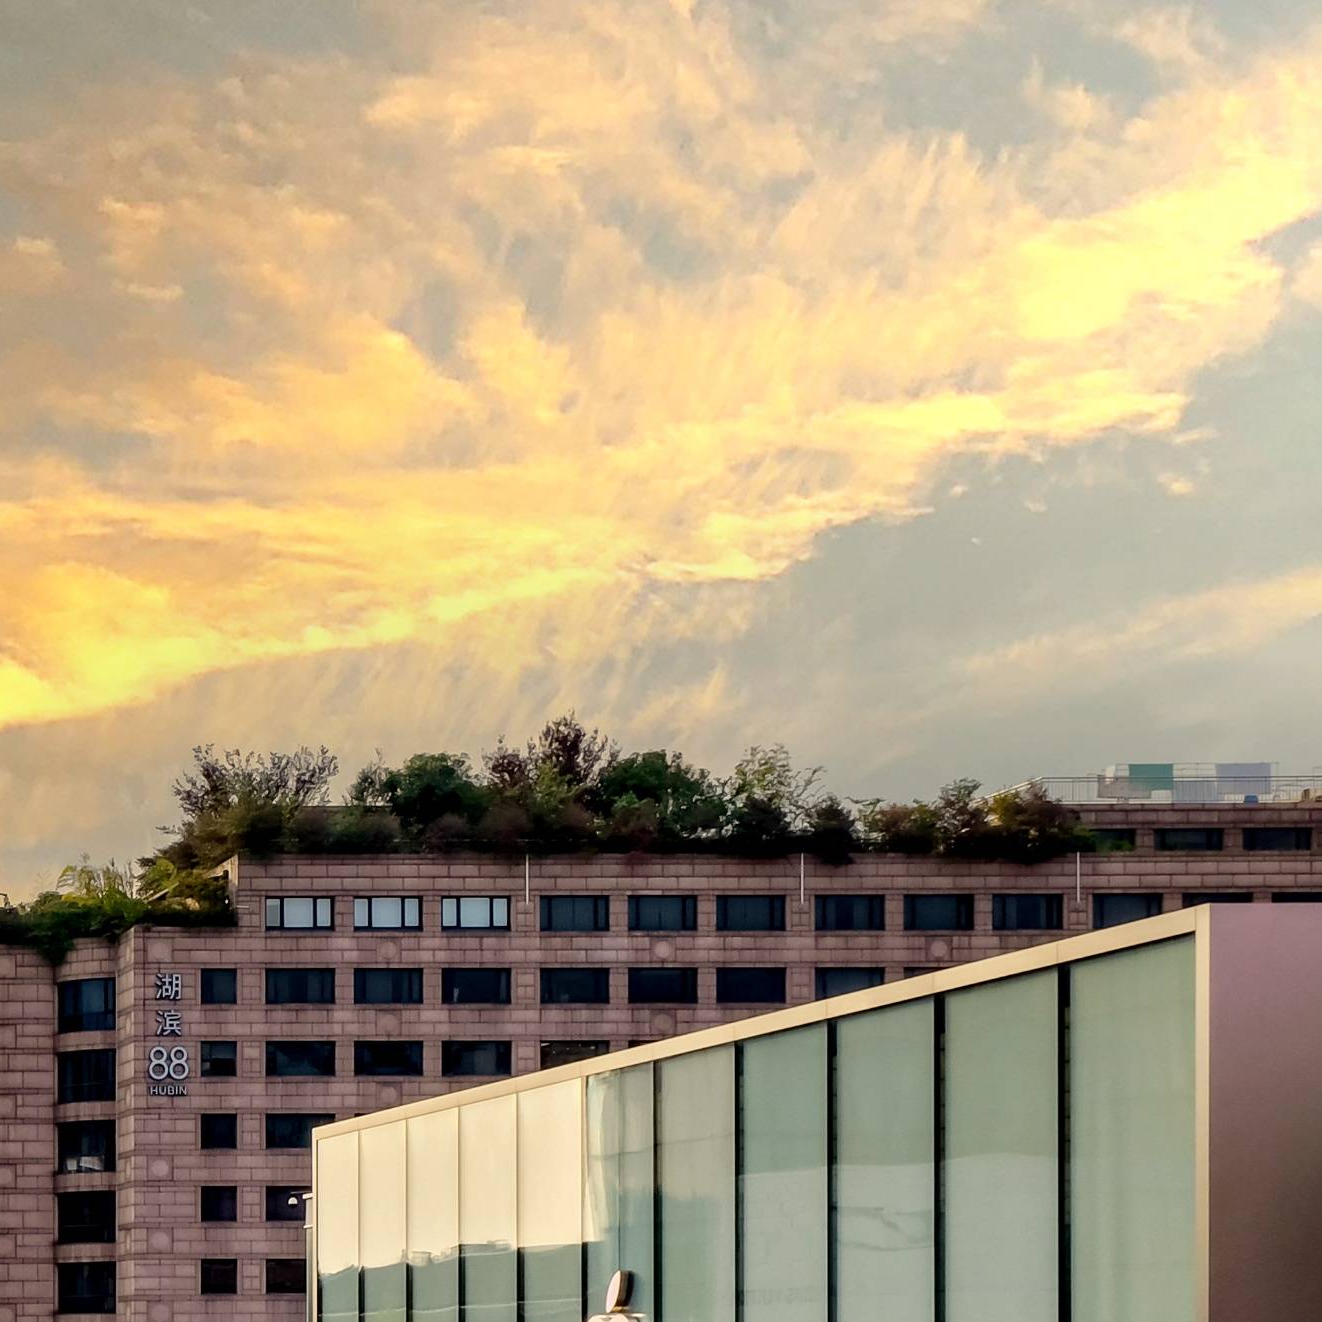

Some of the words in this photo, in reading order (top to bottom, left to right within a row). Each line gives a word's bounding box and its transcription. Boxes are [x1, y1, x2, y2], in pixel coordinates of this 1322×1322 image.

[155, 972, 183, 1036] 湖滨
[148, 1046, 189, 1080] 88
[149, 1084, 187, 1096] HUBIN
